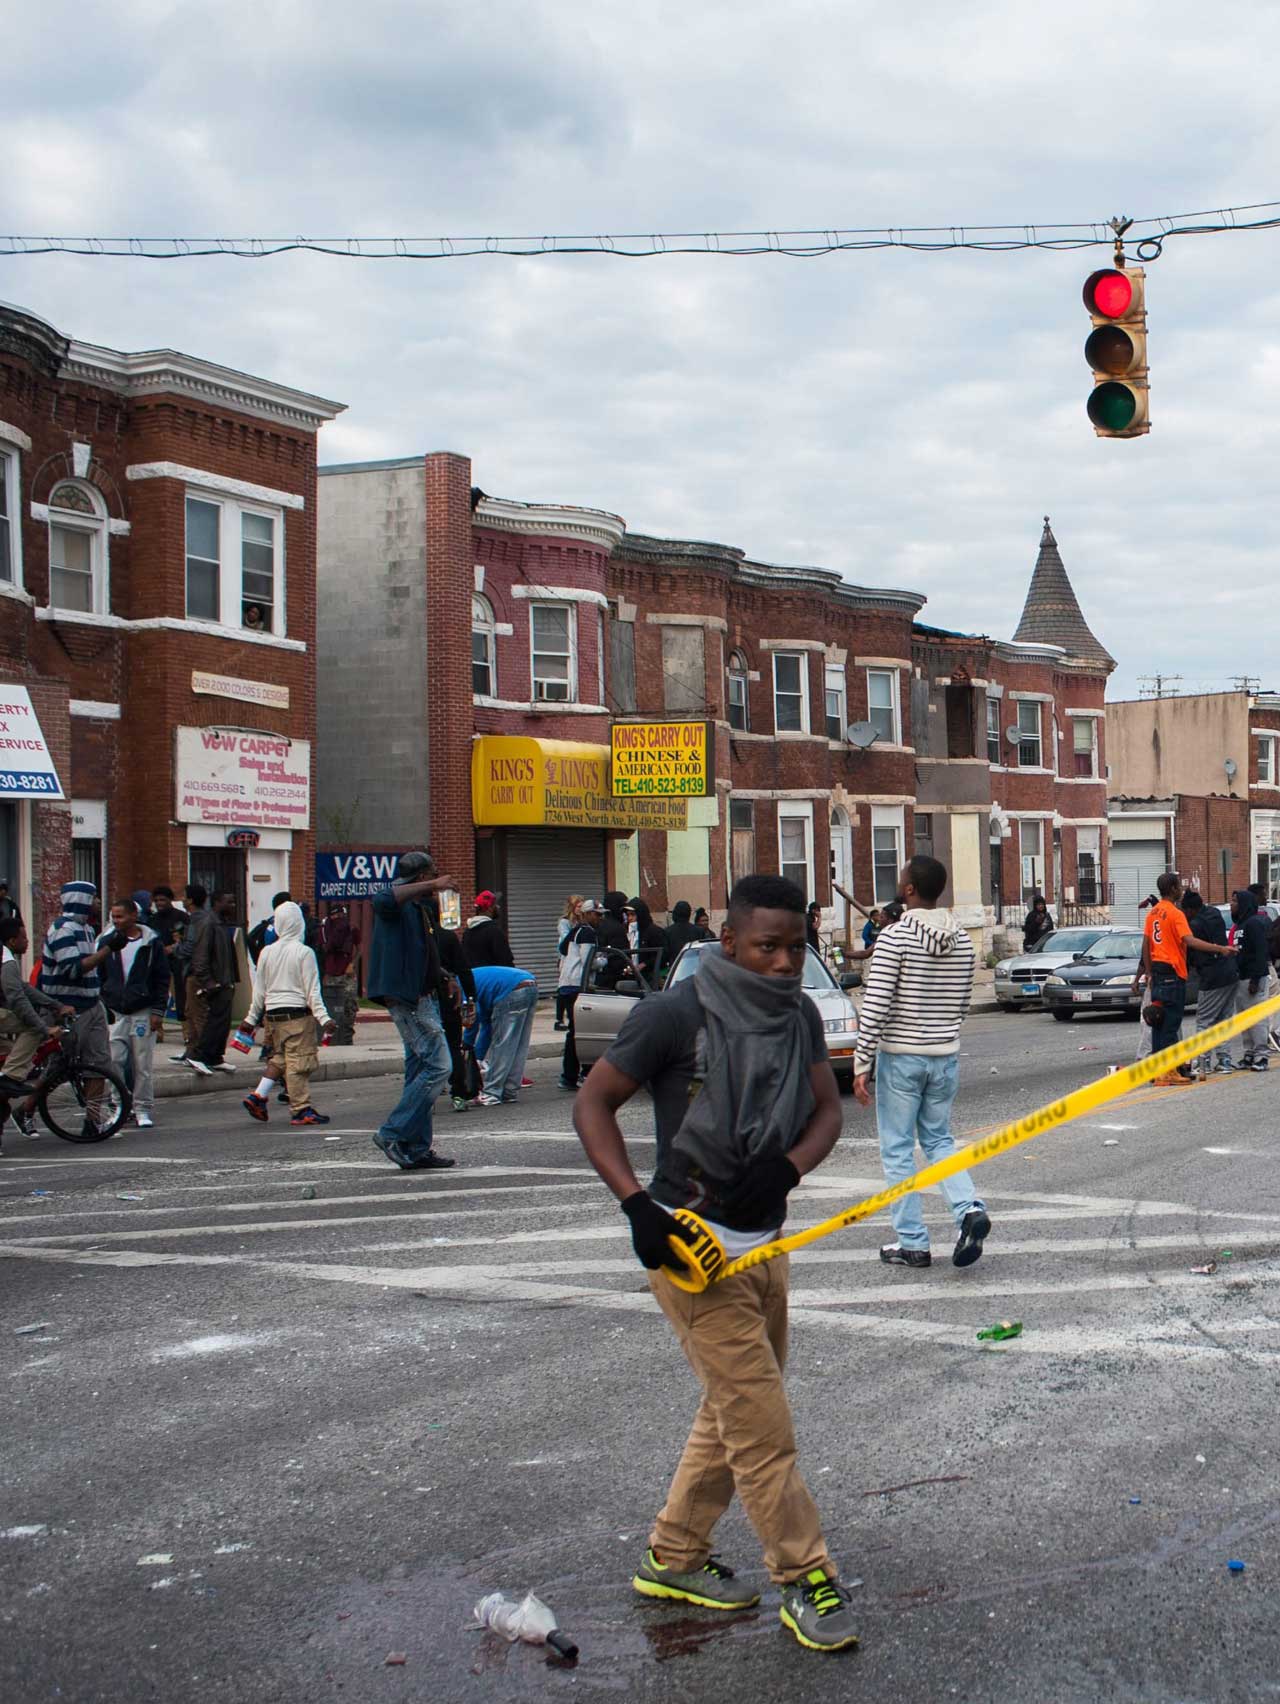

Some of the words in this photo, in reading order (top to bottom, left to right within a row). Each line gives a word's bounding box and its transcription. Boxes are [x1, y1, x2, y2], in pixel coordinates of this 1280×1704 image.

[615, 727, 646, 748] KING'S
[648, 726, 680, 748] CARRY
[684, 725, 704, 747] OUT
[240, 737, 290, 757] CARPET
[616, 750, 685, 762] CHINESE
[688, 749, 701, 761] &
[239, 756, 265, 769] Sales
[267, 761, 285, 772] and
[490, 758, 534, 781] KING'S
[617, 763, 671, 776] AMERICAN
[674, 762, 702, 775] FOOD
[0, 774, 55, 790] 30-8281
[560, 759, 599, 791] KING'S
[614, 778, 704, 794] TEL:410-523-8139
[221, 798, 231, 808] of
[491, 785, 514, 805] CARRY
[519, 785, 535, 804] OUT
[545, 788, 582, 809] Delicious
[584, 791, 617, 812] Chinese
[544, 810, 563, 822] 1736
[563, 810, 583, 823] West
[585, 812, 609, 825] North
[334, 855, 398, 880] V&W
[321, 882, 347, 896] CARPET
[347, 882, 367, 896] SALES
